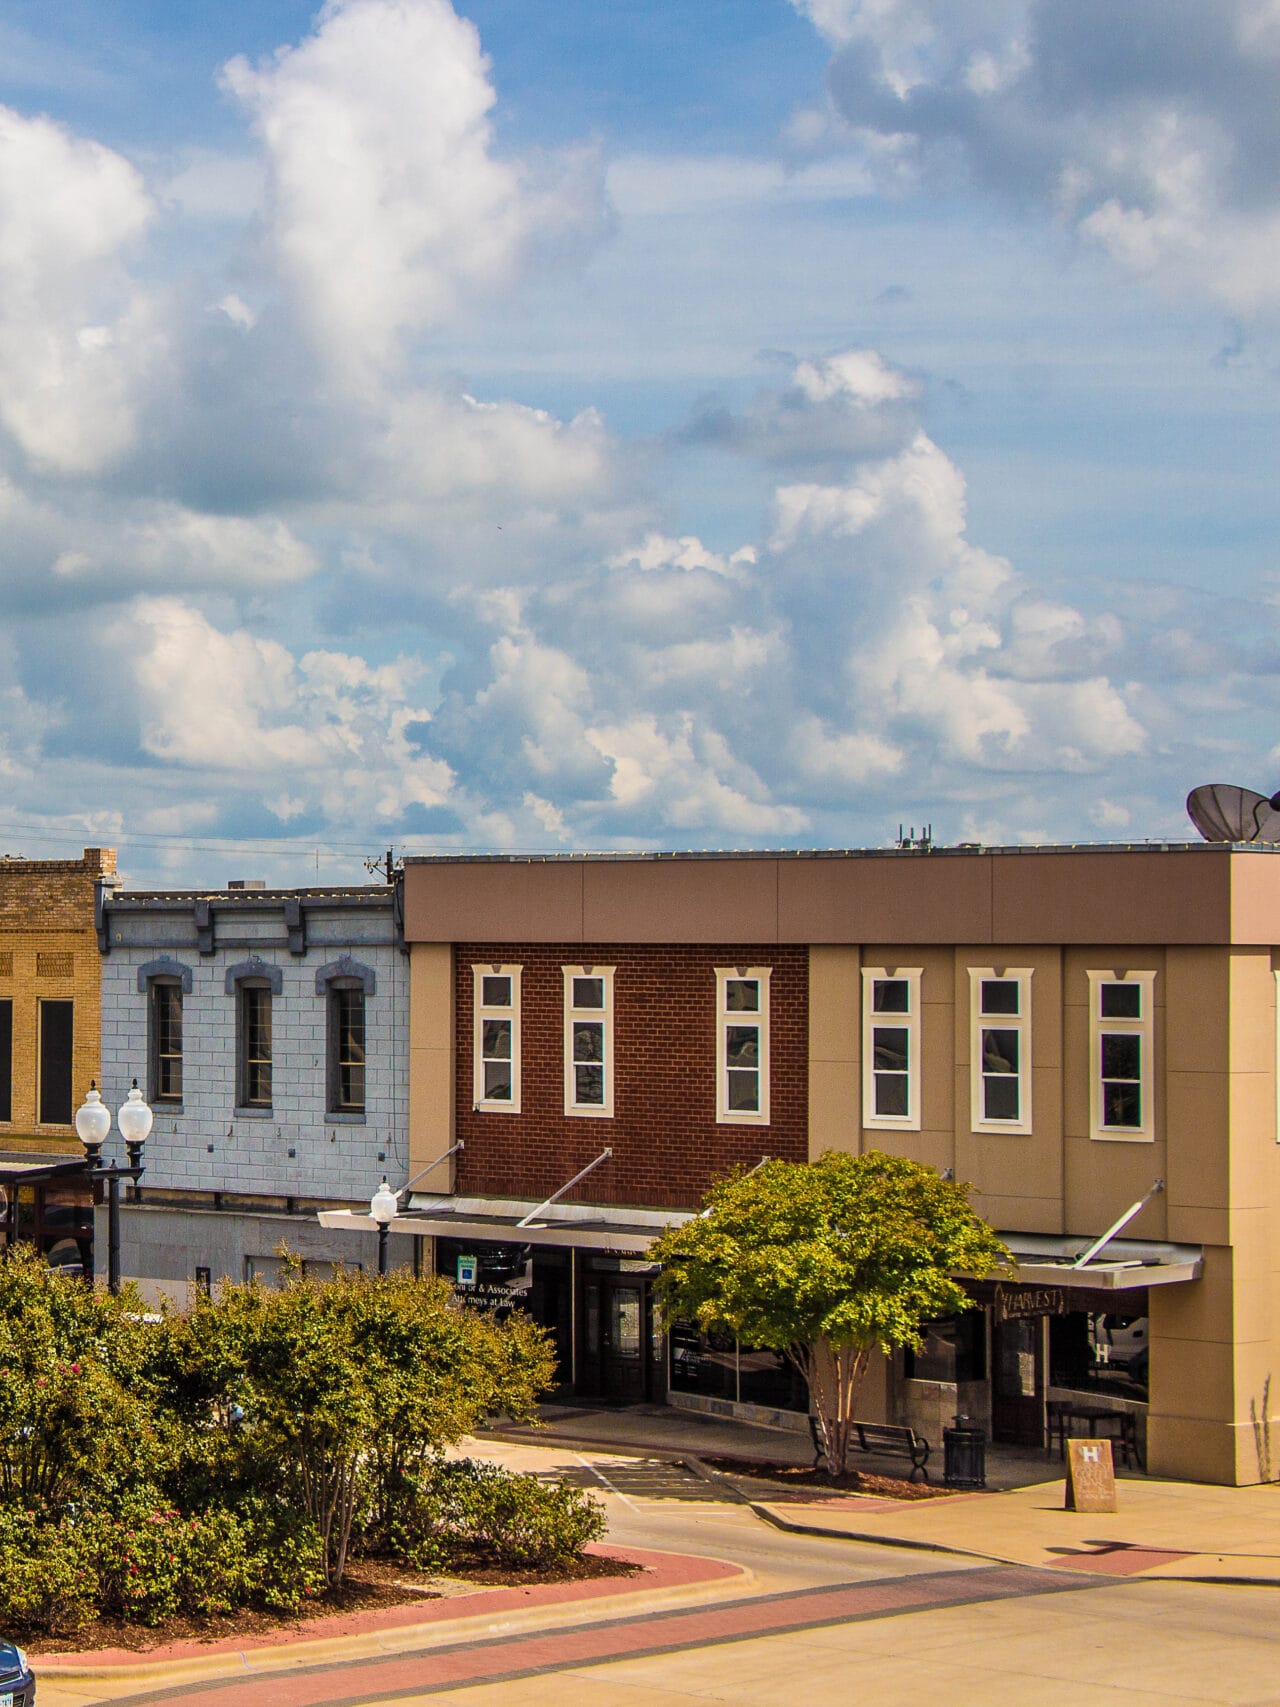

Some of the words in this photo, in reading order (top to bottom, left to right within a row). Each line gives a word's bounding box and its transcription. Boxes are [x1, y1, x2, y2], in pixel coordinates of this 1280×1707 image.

[478, 1283, 485, 1293] &
[487, 1284, 528, 1297] Associates
[489, 1298, 497, 1306] at
[500, 1298, 515, 1308] Law
[1008, 1290, 1057, 1311] HARVEST
[1095, 1343, 1109, 1363] H
[1082, 1446, 1099, 1463] H
